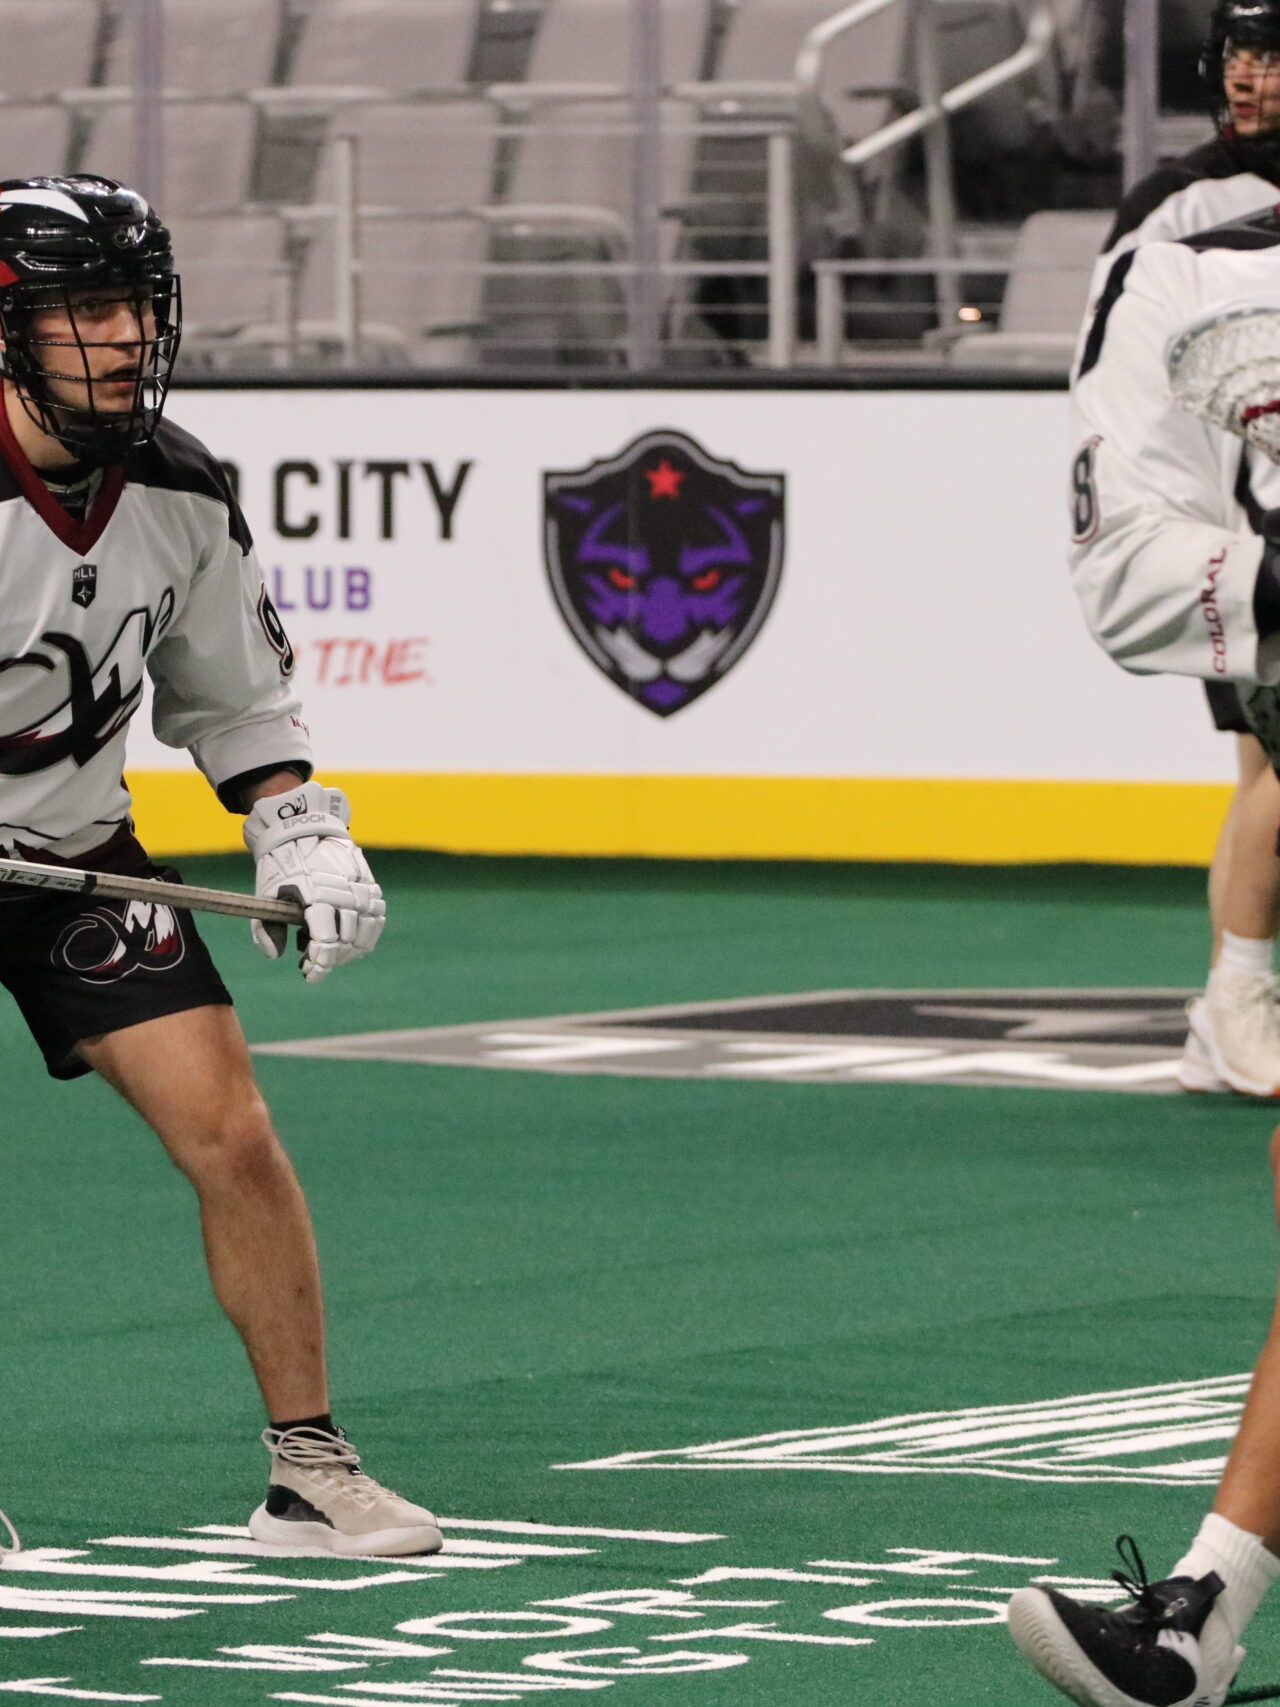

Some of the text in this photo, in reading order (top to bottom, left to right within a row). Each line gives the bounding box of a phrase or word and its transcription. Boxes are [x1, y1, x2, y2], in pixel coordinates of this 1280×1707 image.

[273, 457, 475, 540] CITY
[73, 567, 96, 579] NLL
[264, 564, 373, 611] LUB
[1200, 545, 1229, 675] COLORA
[282, 813, 326, 831] EPOCH
